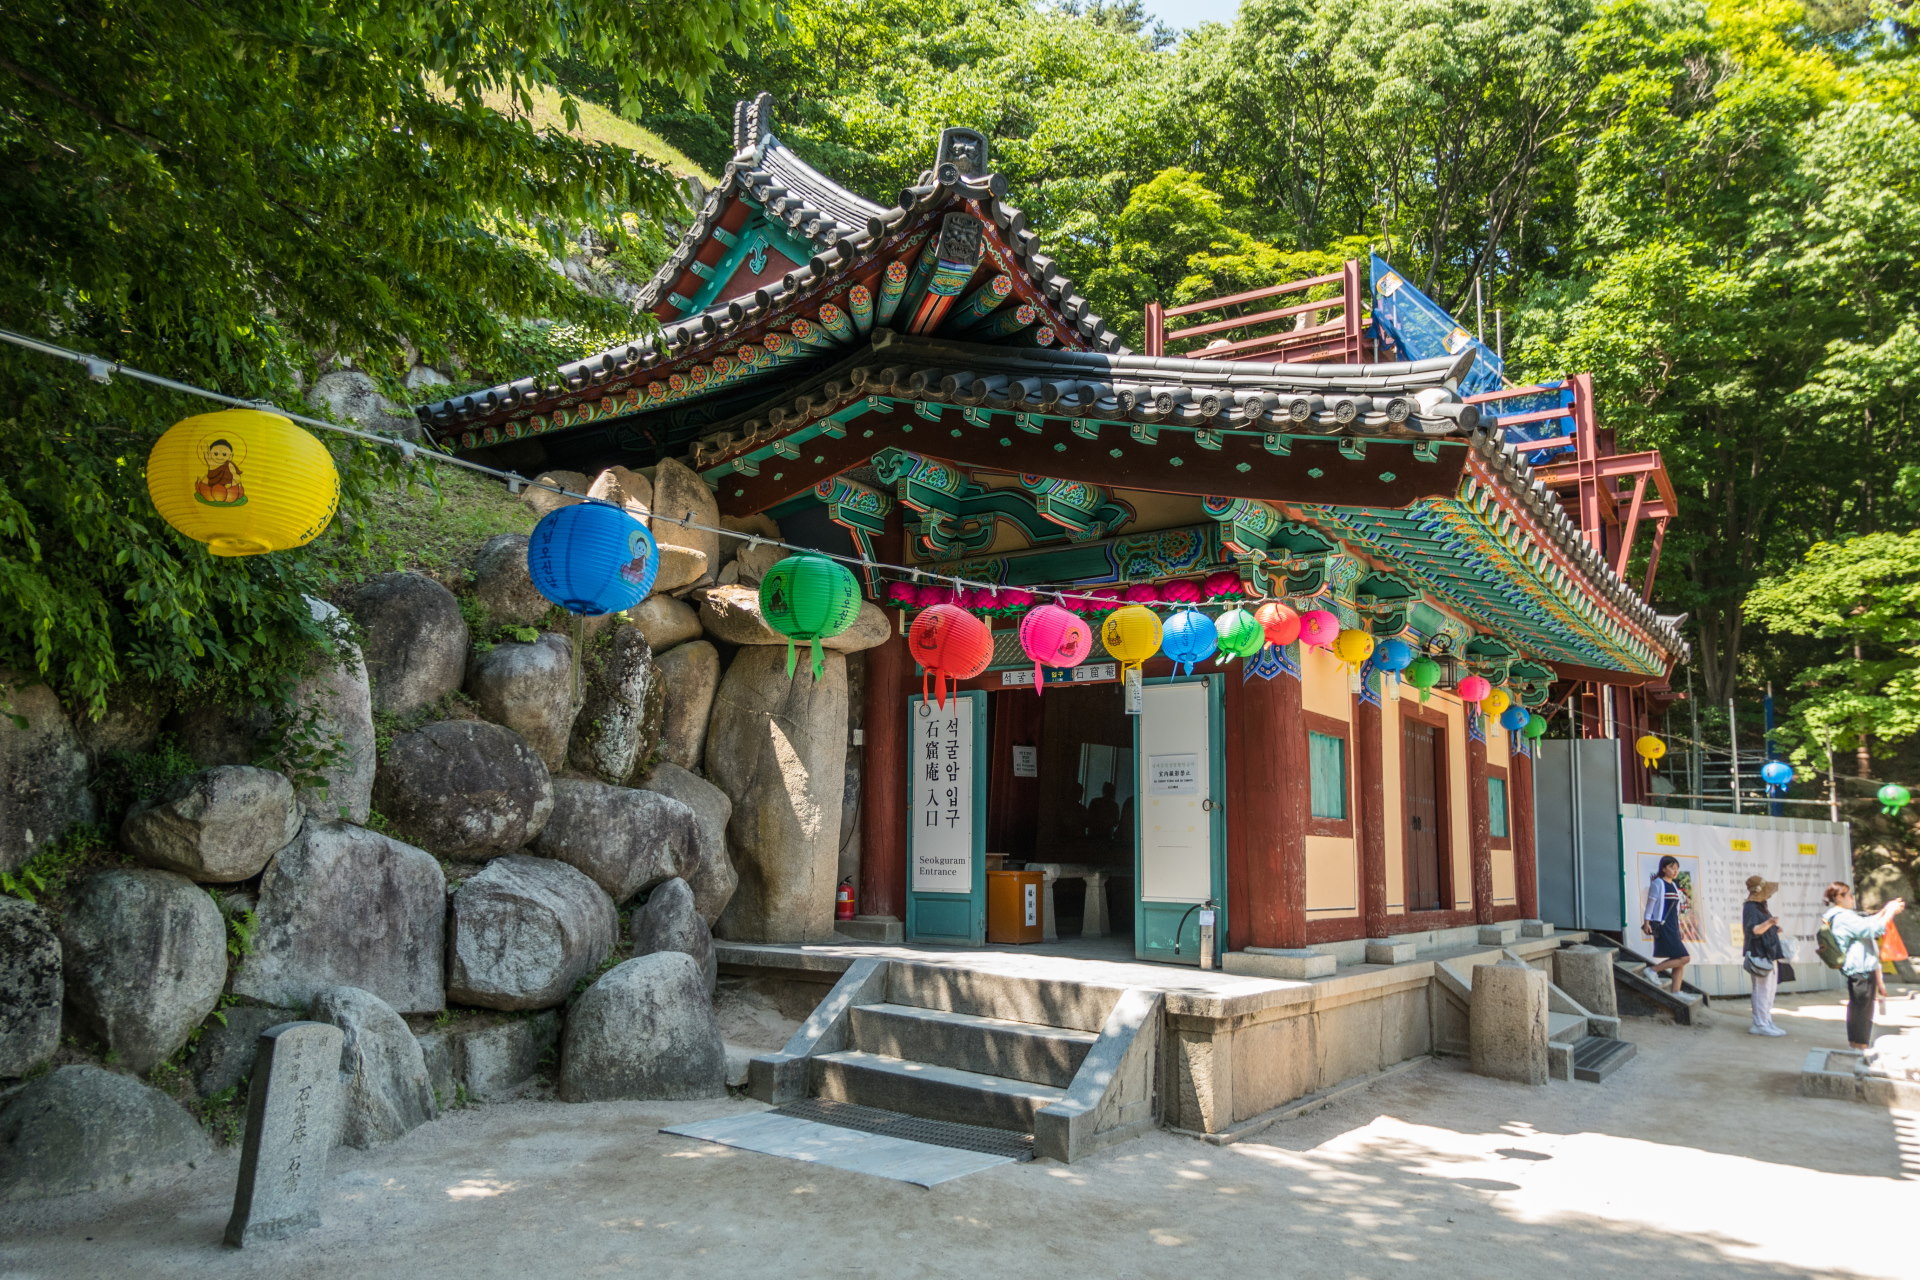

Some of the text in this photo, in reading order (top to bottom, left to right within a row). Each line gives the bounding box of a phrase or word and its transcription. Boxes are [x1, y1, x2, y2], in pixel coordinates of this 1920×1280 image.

[925, 719, 940, 828] 石窟庵 入口
[945, 717, 961, 829] 석굴암 입구
[919, 855, 966, 866] Seokguram
[919, 866, 957, 876] Entrance
